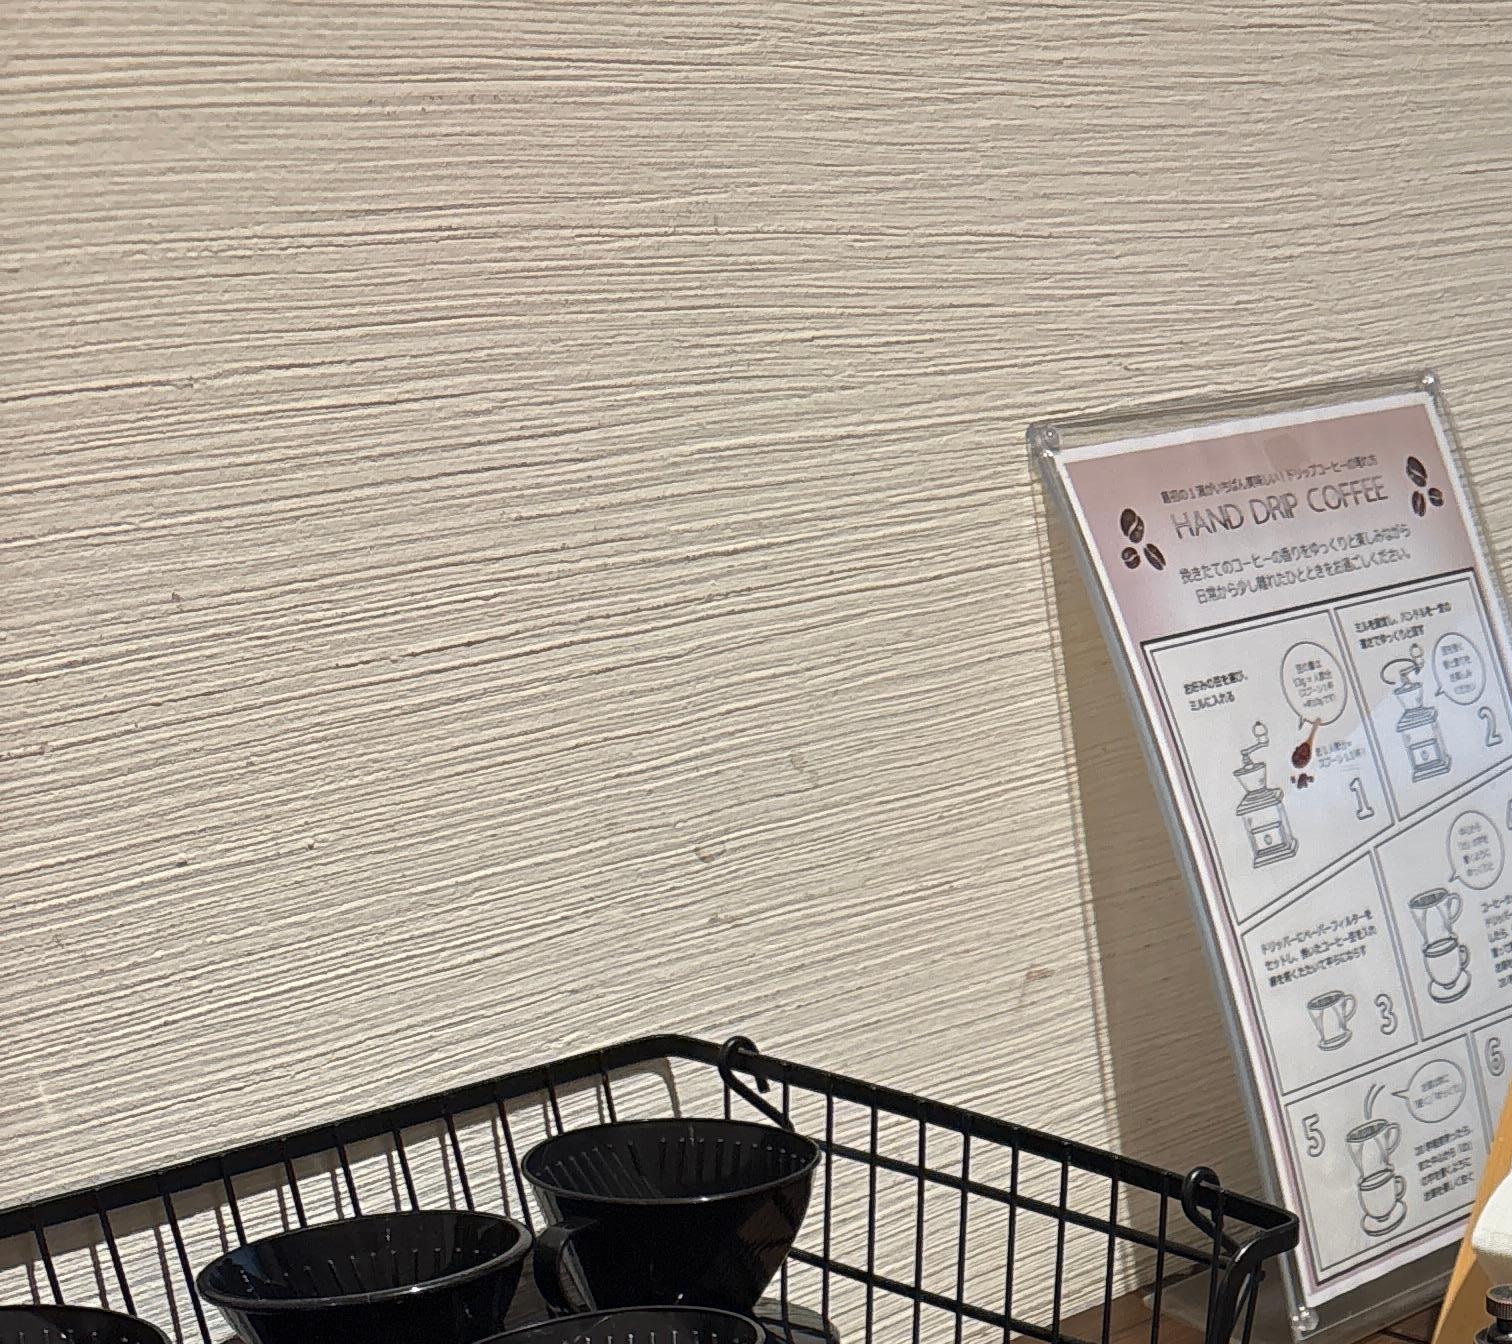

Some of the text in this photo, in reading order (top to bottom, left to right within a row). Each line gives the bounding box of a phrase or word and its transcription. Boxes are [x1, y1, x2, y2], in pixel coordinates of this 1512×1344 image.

[1170, 476, 1388, 539] HAND DRIP COFFEE
[1478, 706, 1503, 747] 2
[1349, 777, 1375, 820] 1
[1373, 993, 1398, 1036] 3
[1484, 1036, 1506, 1077] 6
[1302, 1113, 1326, 1158] 5
